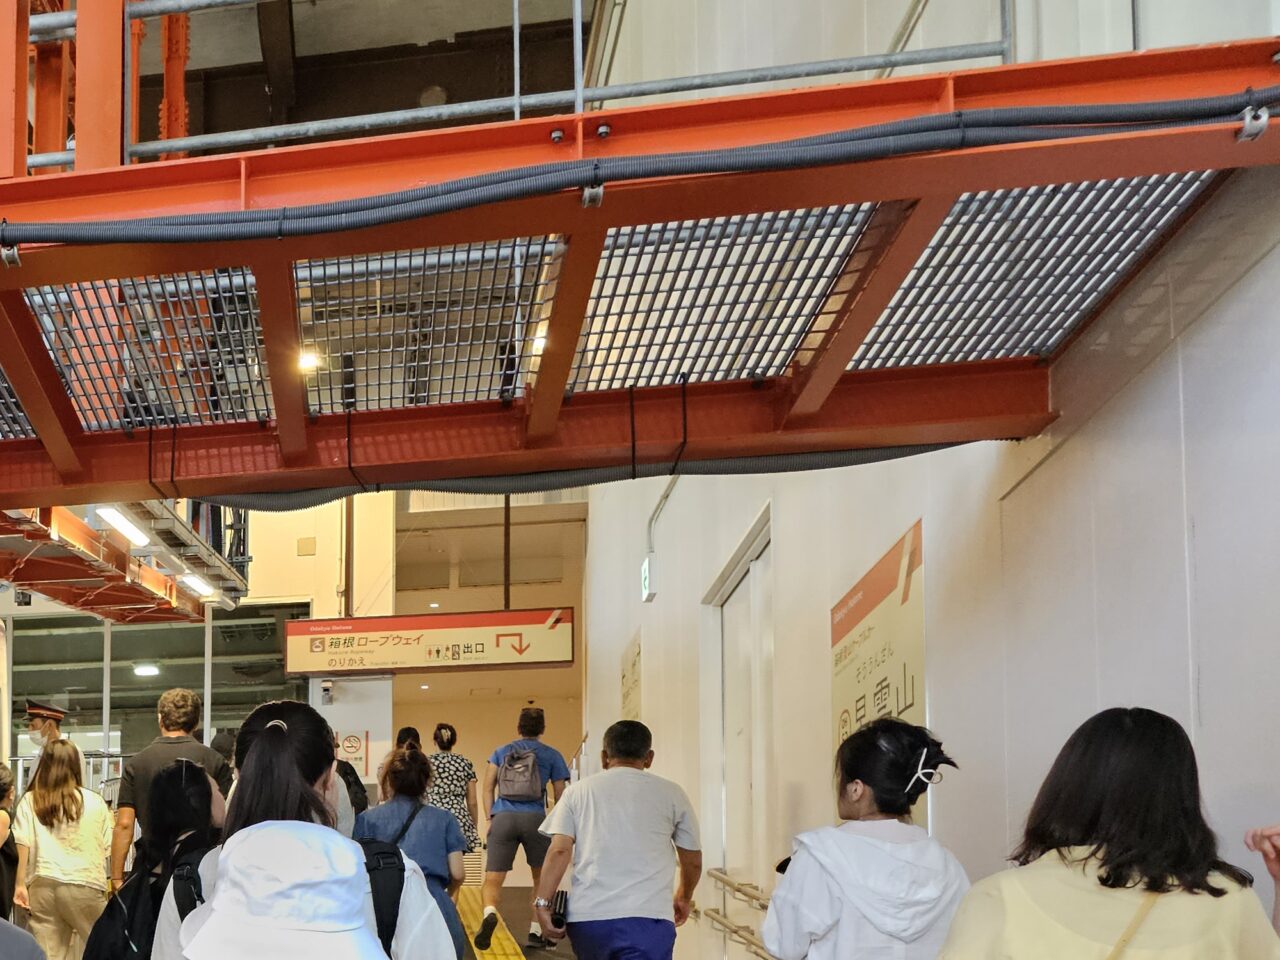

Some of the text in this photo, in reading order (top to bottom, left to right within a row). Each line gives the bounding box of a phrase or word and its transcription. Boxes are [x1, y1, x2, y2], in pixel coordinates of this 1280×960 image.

[328, 633, 424, 650] 箱根ロープウェイ
[463, 642, 485, 654] 出口
[328, 656, 366, 668] のりかえ
